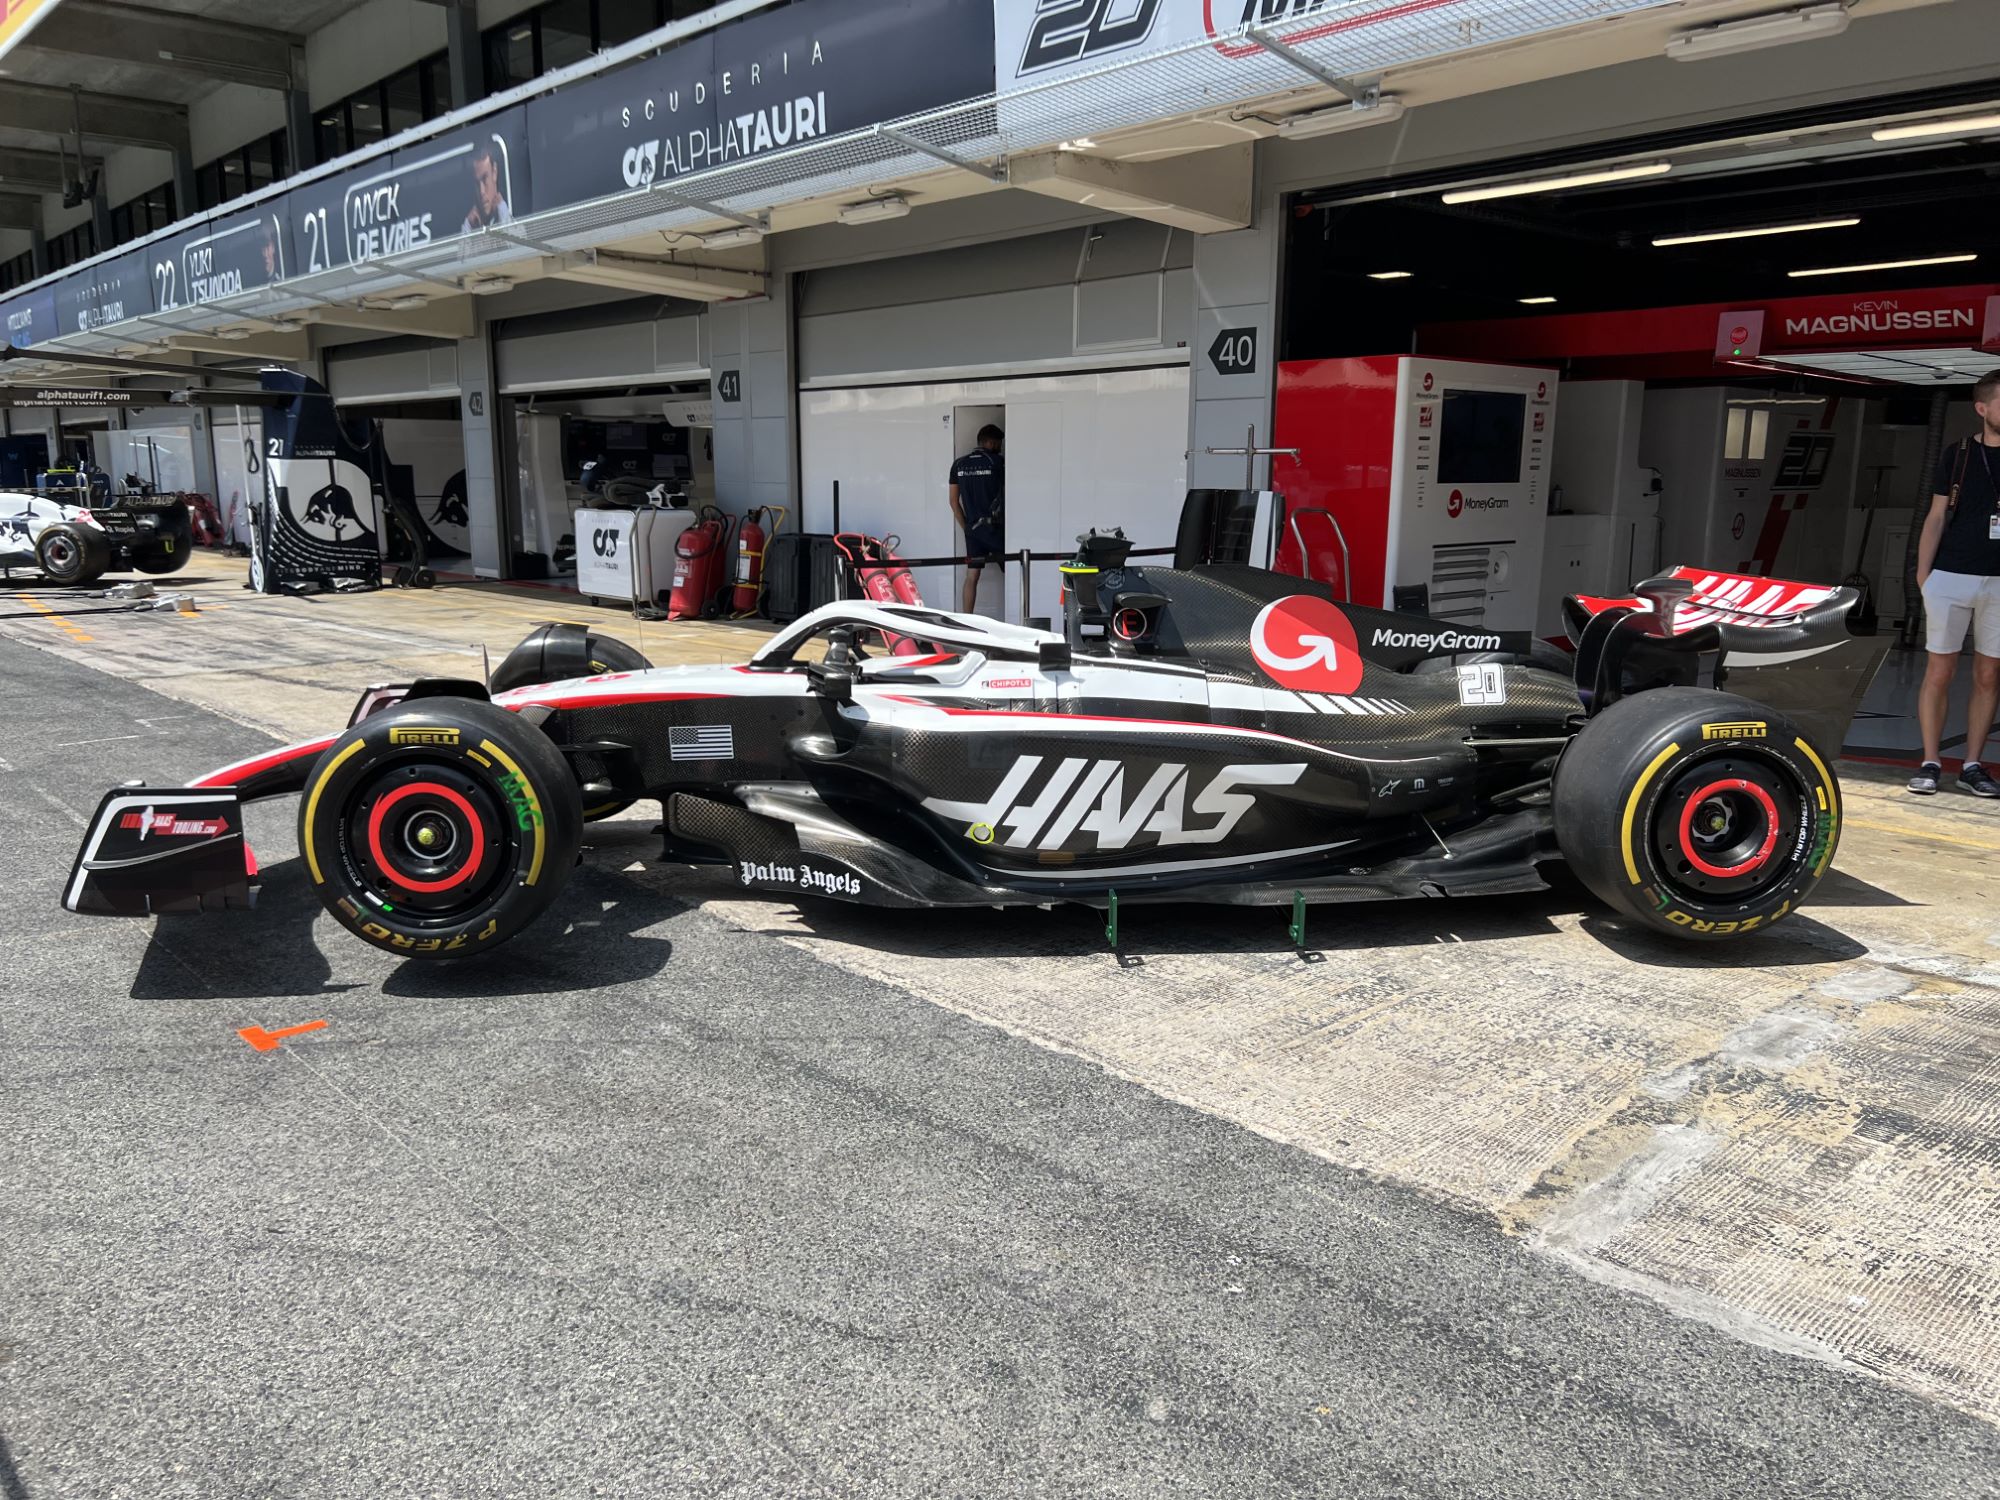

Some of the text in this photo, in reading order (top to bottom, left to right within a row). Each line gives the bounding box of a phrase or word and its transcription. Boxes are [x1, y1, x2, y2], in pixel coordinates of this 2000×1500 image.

[622, 40, 823, 128] SCUDERIA
[663, 91, 826, 177] ALPHATAURI
[354, 183, 400, 229] NYCK
[304, 207, 331, 273] 21
[357, 213, 432, 262] DE VRIES
[189, 248, 213, 276] YUKI
[155, 260, 178, 311] 22
[191, 269, 243, 302] TSUNODA
[1786, 308, 1974, 335] MAGNUSSEN
[1853, 300, 1898, 312] KEVIN
[1219, 336, 1253, 367] 40
[37, 390, 130, 401] alphataurif1.com
[722, 375, 738, 397] 41
[471, 396, 483, 412] 42
[268, 438, 284, 456] 21
[1464, 497, 1509, 512] MoneyGram
[1371, 628, 1501, 653] MoneyGram
[991, 680, 1030, 688] CHIPOTLE
[1456, 663, 1506, 706] 20
[389, 727, 461, 744] PIRELLI
[1701, 721, 1767, 740] PIRELLI
[496, 771, 543, 832] MAG
[920, 755, 1308, 850] HAAS
[740, 861, 860, 895] Palm Angels
[1665, 899, 1790, 934] P ZERO
[361, 919, 497, 951] P ZERO
